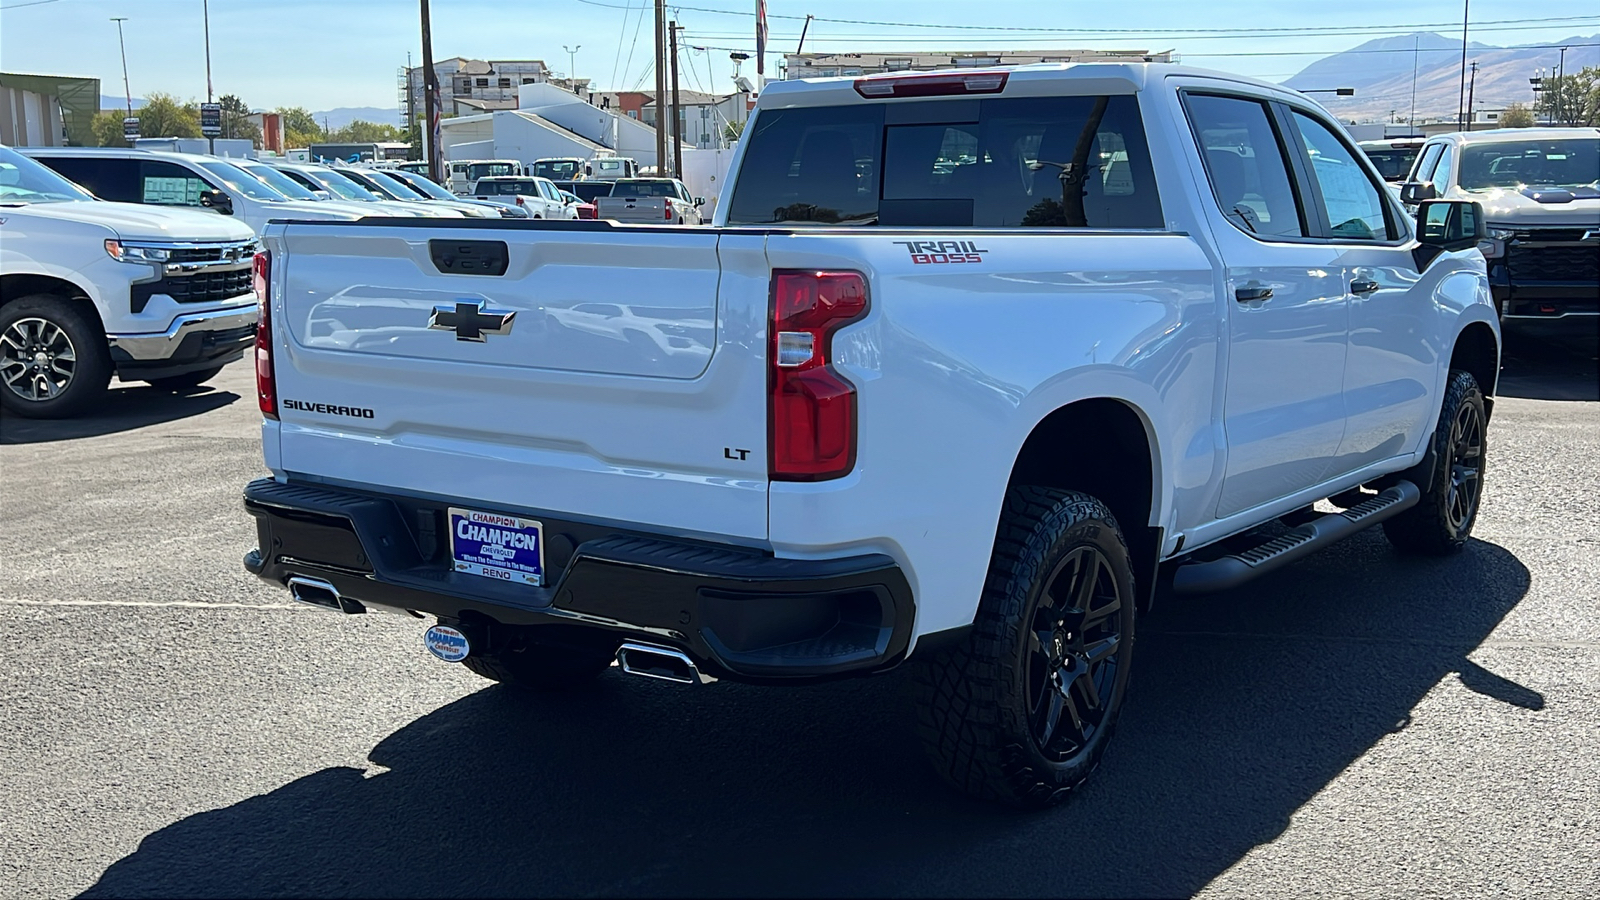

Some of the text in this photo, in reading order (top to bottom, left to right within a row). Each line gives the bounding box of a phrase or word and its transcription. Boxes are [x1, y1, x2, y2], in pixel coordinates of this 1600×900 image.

[892, 241, 989, 253] TRAIL
[911, 253, 982, 264] BOSS
[283, 399, 375, 419] SILVERADO
[724, 447, 751, 461] LT
[472, 513, 516, 527] CHAMPION
[457, 519, 536, 551] CHAMPION
[482, 546, 513, 558] CHEVROLET
[482, 567, 511, 580] RENO
